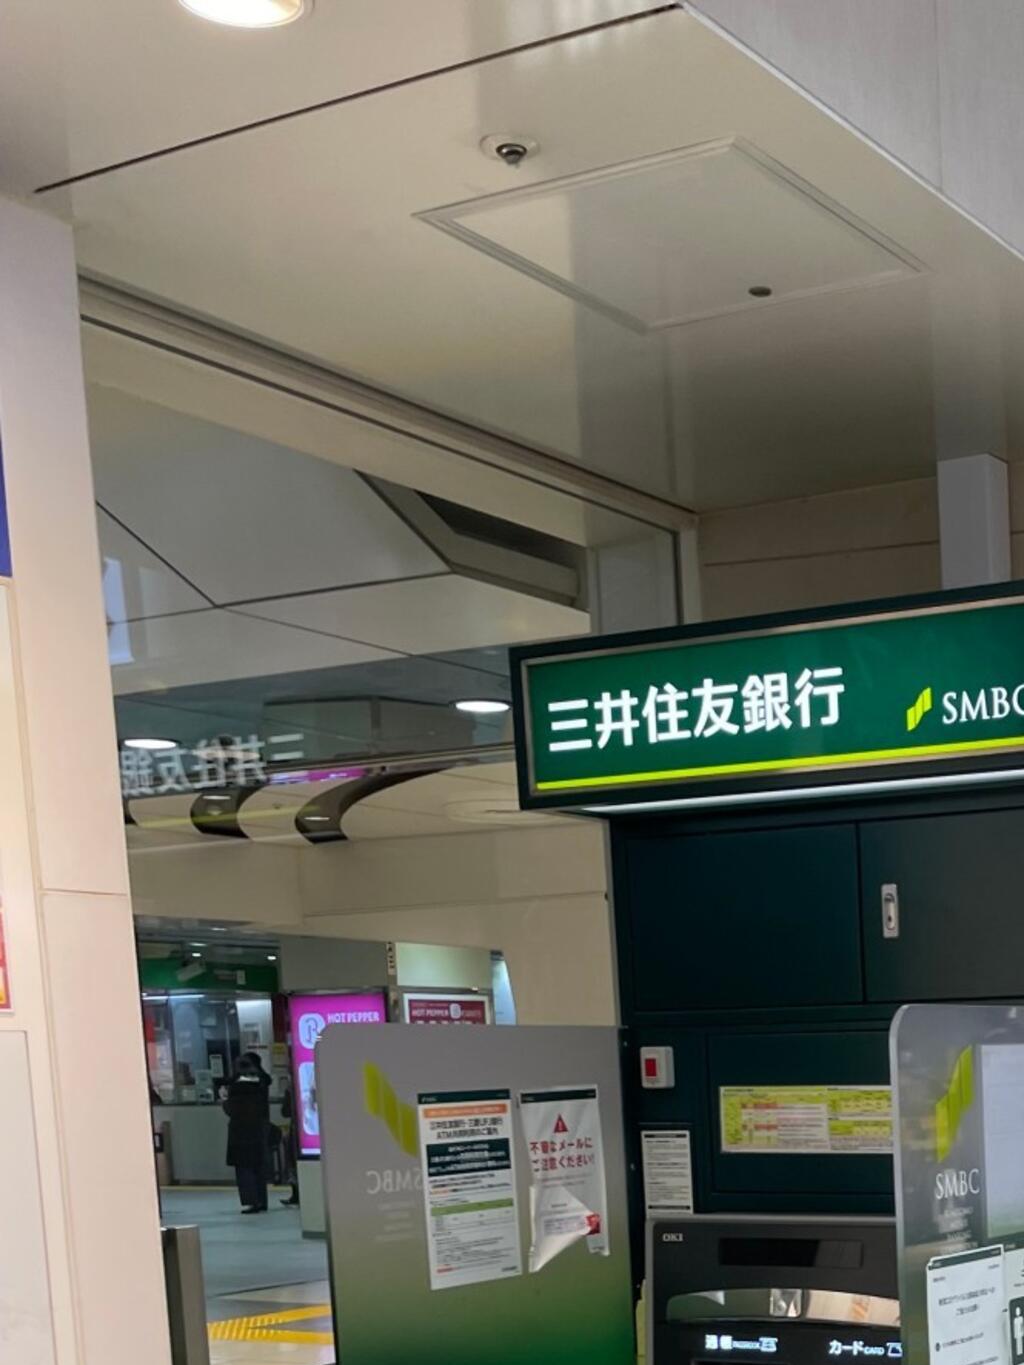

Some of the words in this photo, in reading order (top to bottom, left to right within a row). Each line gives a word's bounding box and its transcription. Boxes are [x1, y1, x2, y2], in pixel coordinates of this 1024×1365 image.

[548, 667, 845, 753] 三井住友銀行
[935, 1167, 980, 1200] SMBC
[828, 1339, 864, 1356] カード
